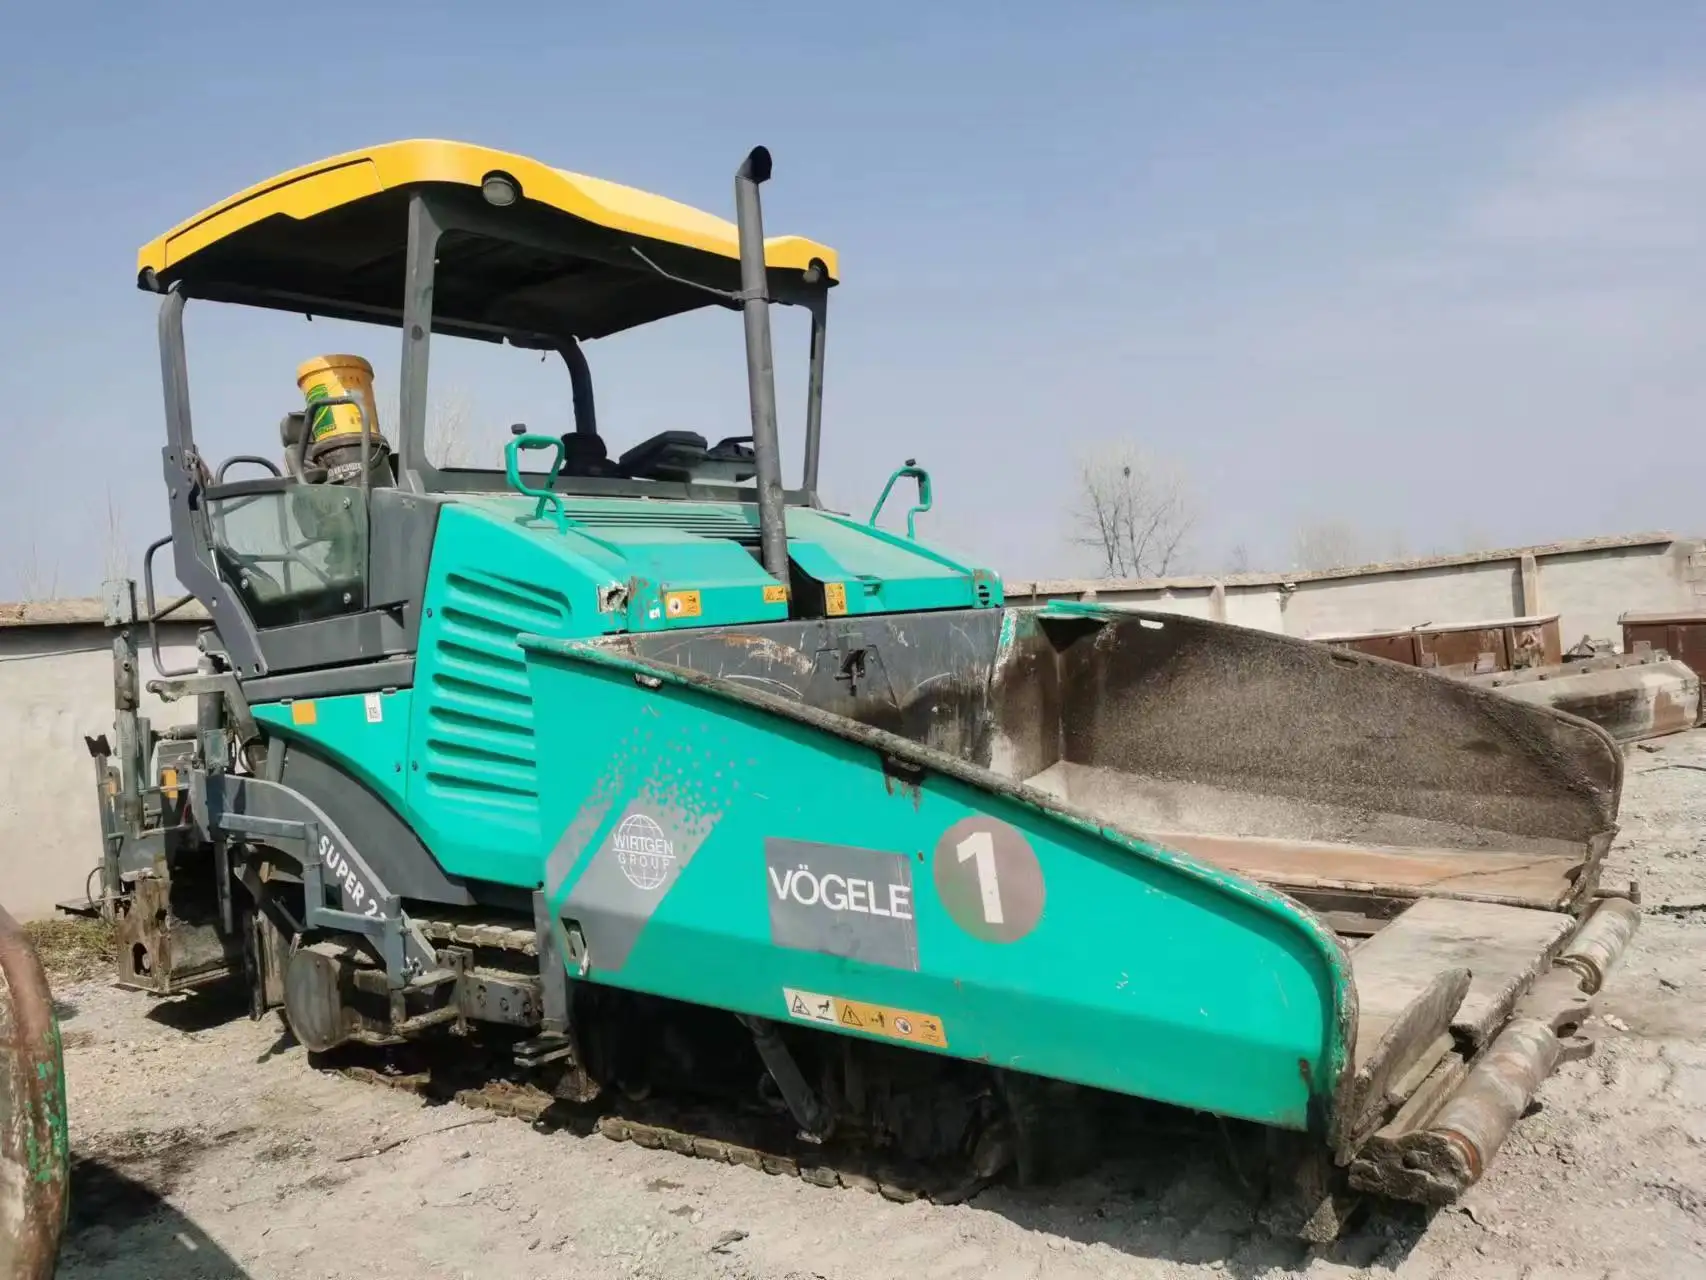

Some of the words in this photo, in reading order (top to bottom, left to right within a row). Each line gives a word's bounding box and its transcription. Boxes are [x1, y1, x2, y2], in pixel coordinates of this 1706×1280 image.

[612, 832, 674, 856] WIRTGEN
[617, 852, 670, 870] GROUP
[319, 835, 365, 907] SUPER
[364, 898, 387, 919] 2
[768, 864, 913, 920] VÖGELE
[955, 831, 1004, 924] 1
